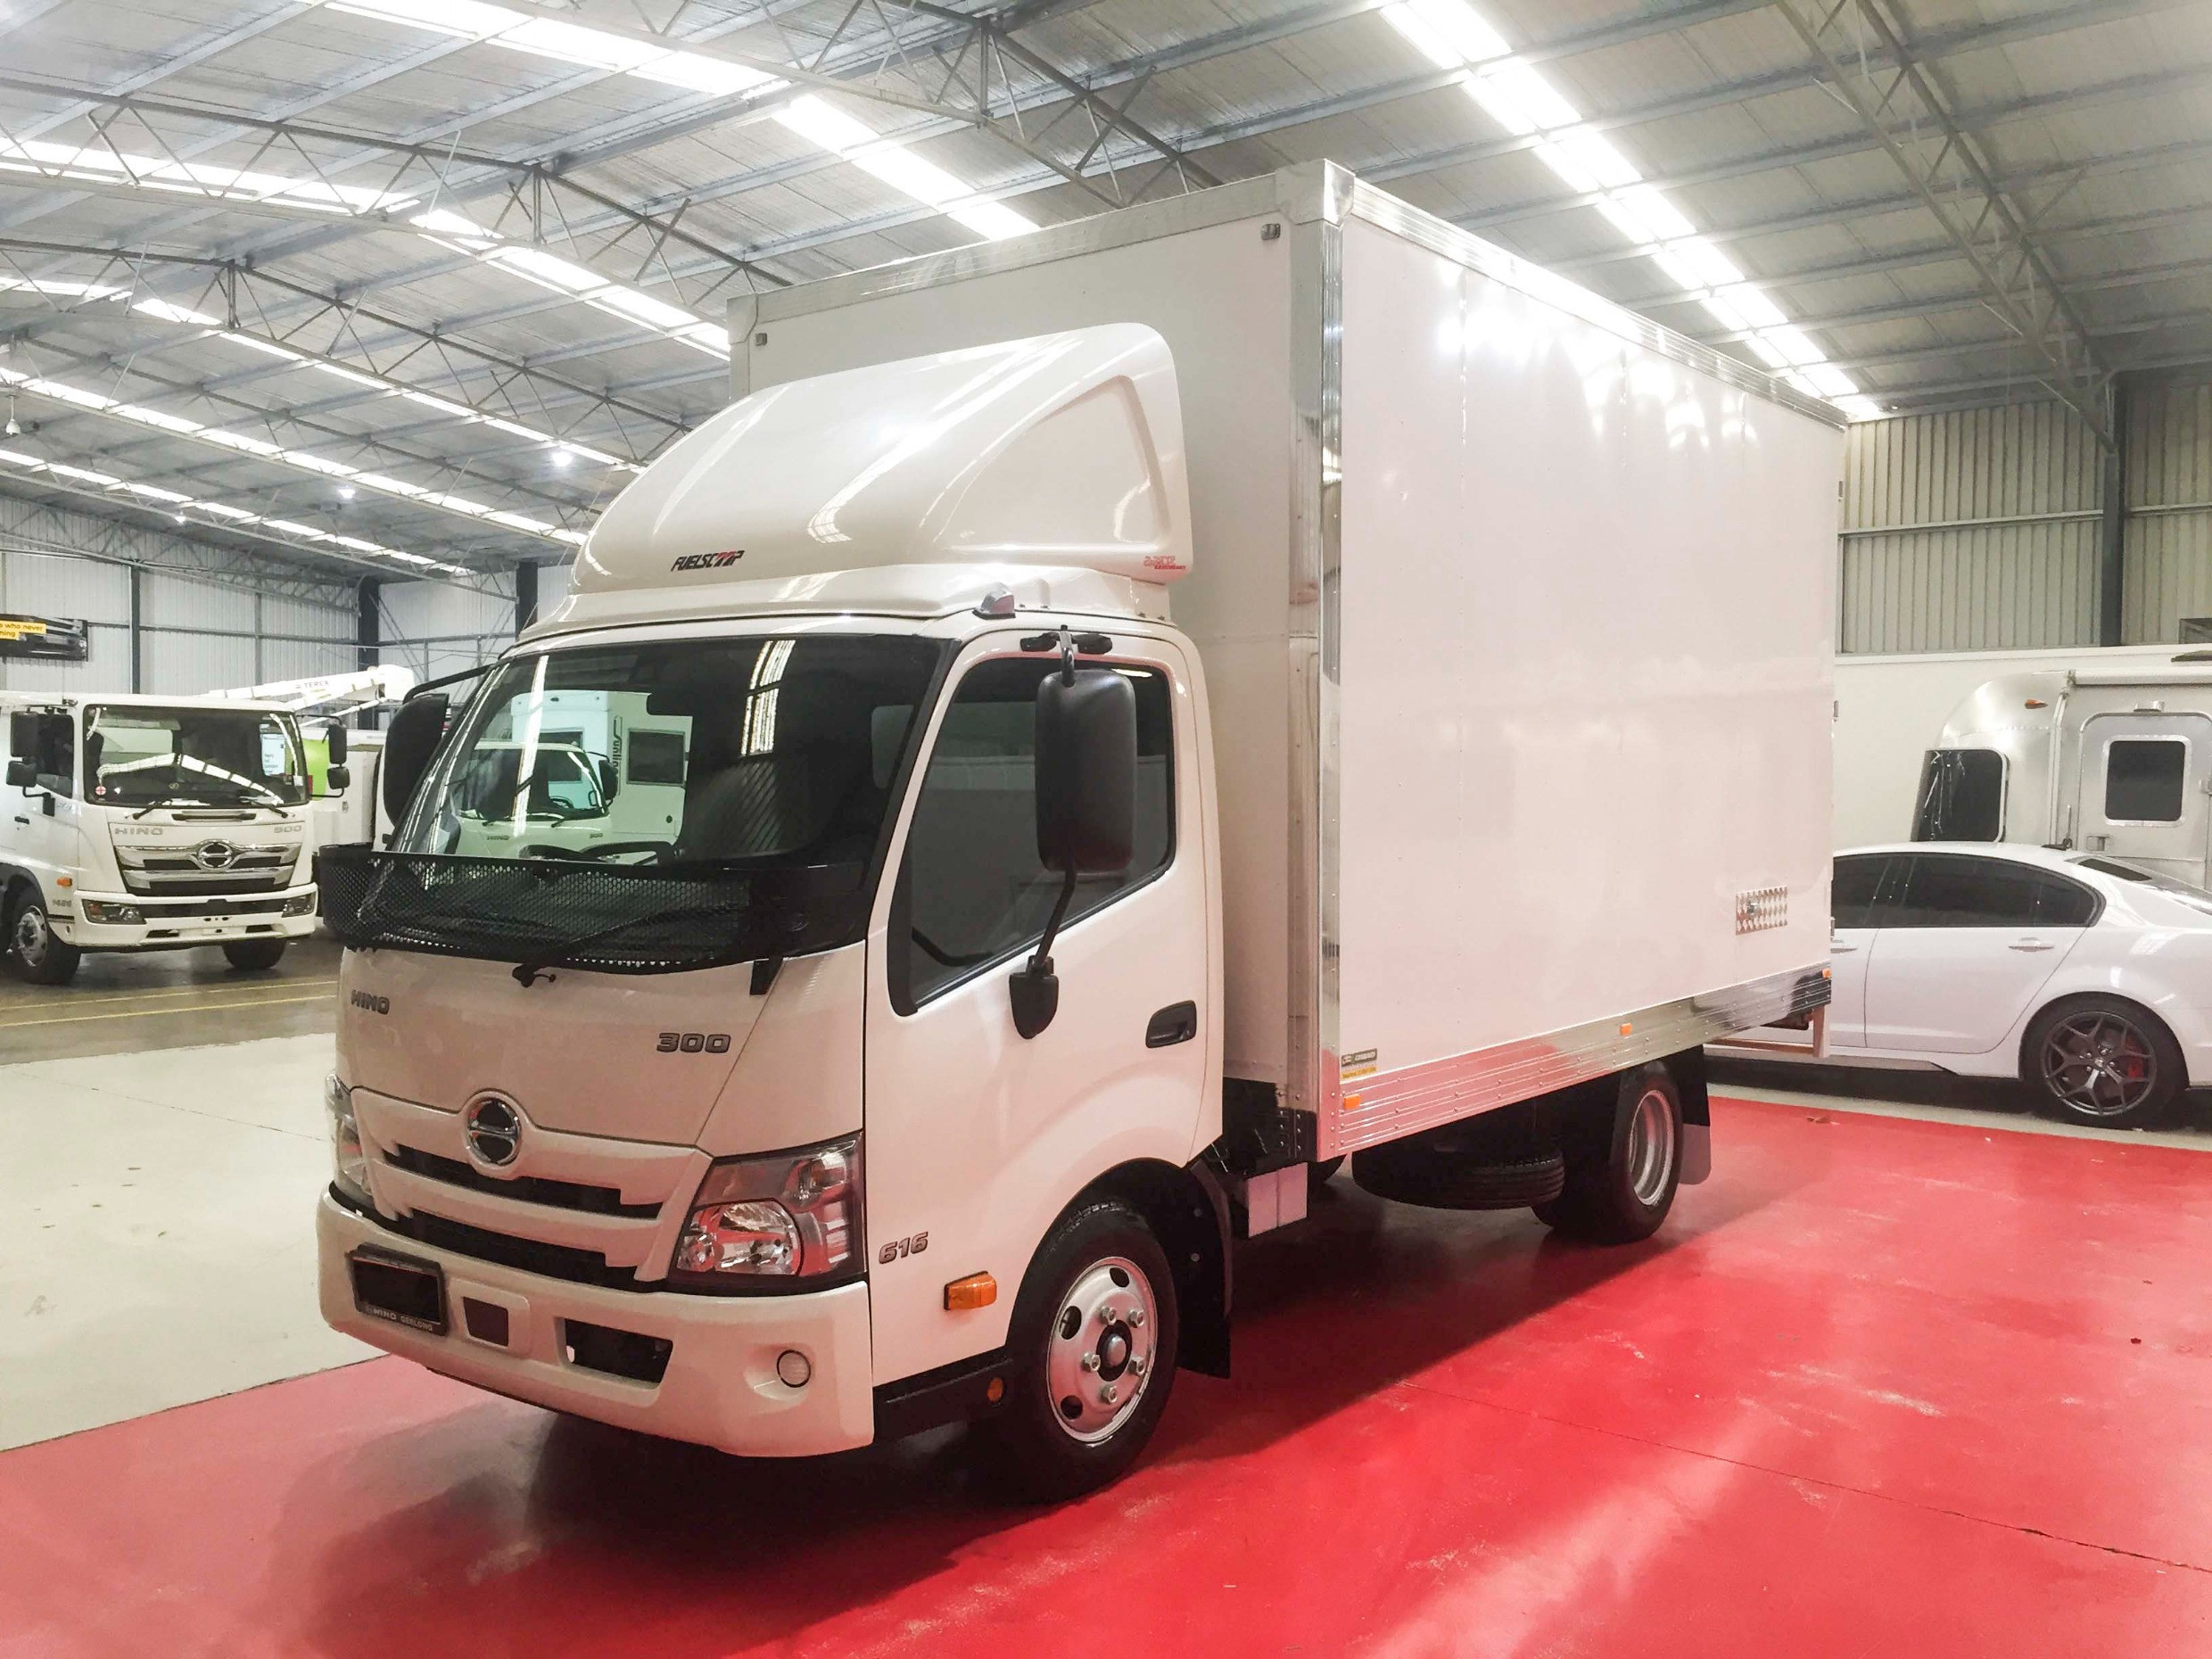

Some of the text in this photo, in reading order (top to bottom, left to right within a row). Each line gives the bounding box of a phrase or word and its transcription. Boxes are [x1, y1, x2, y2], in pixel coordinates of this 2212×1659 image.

[114, 827, 163, 836] HINO
[274, 825, 302, 834] 500
[351, 989, 390, 1015] HINO
[656, 1032, 731, 1053] 300
[878, 1231, 929, 1265] 616
[373, 1308, 398, 1321] HINO
